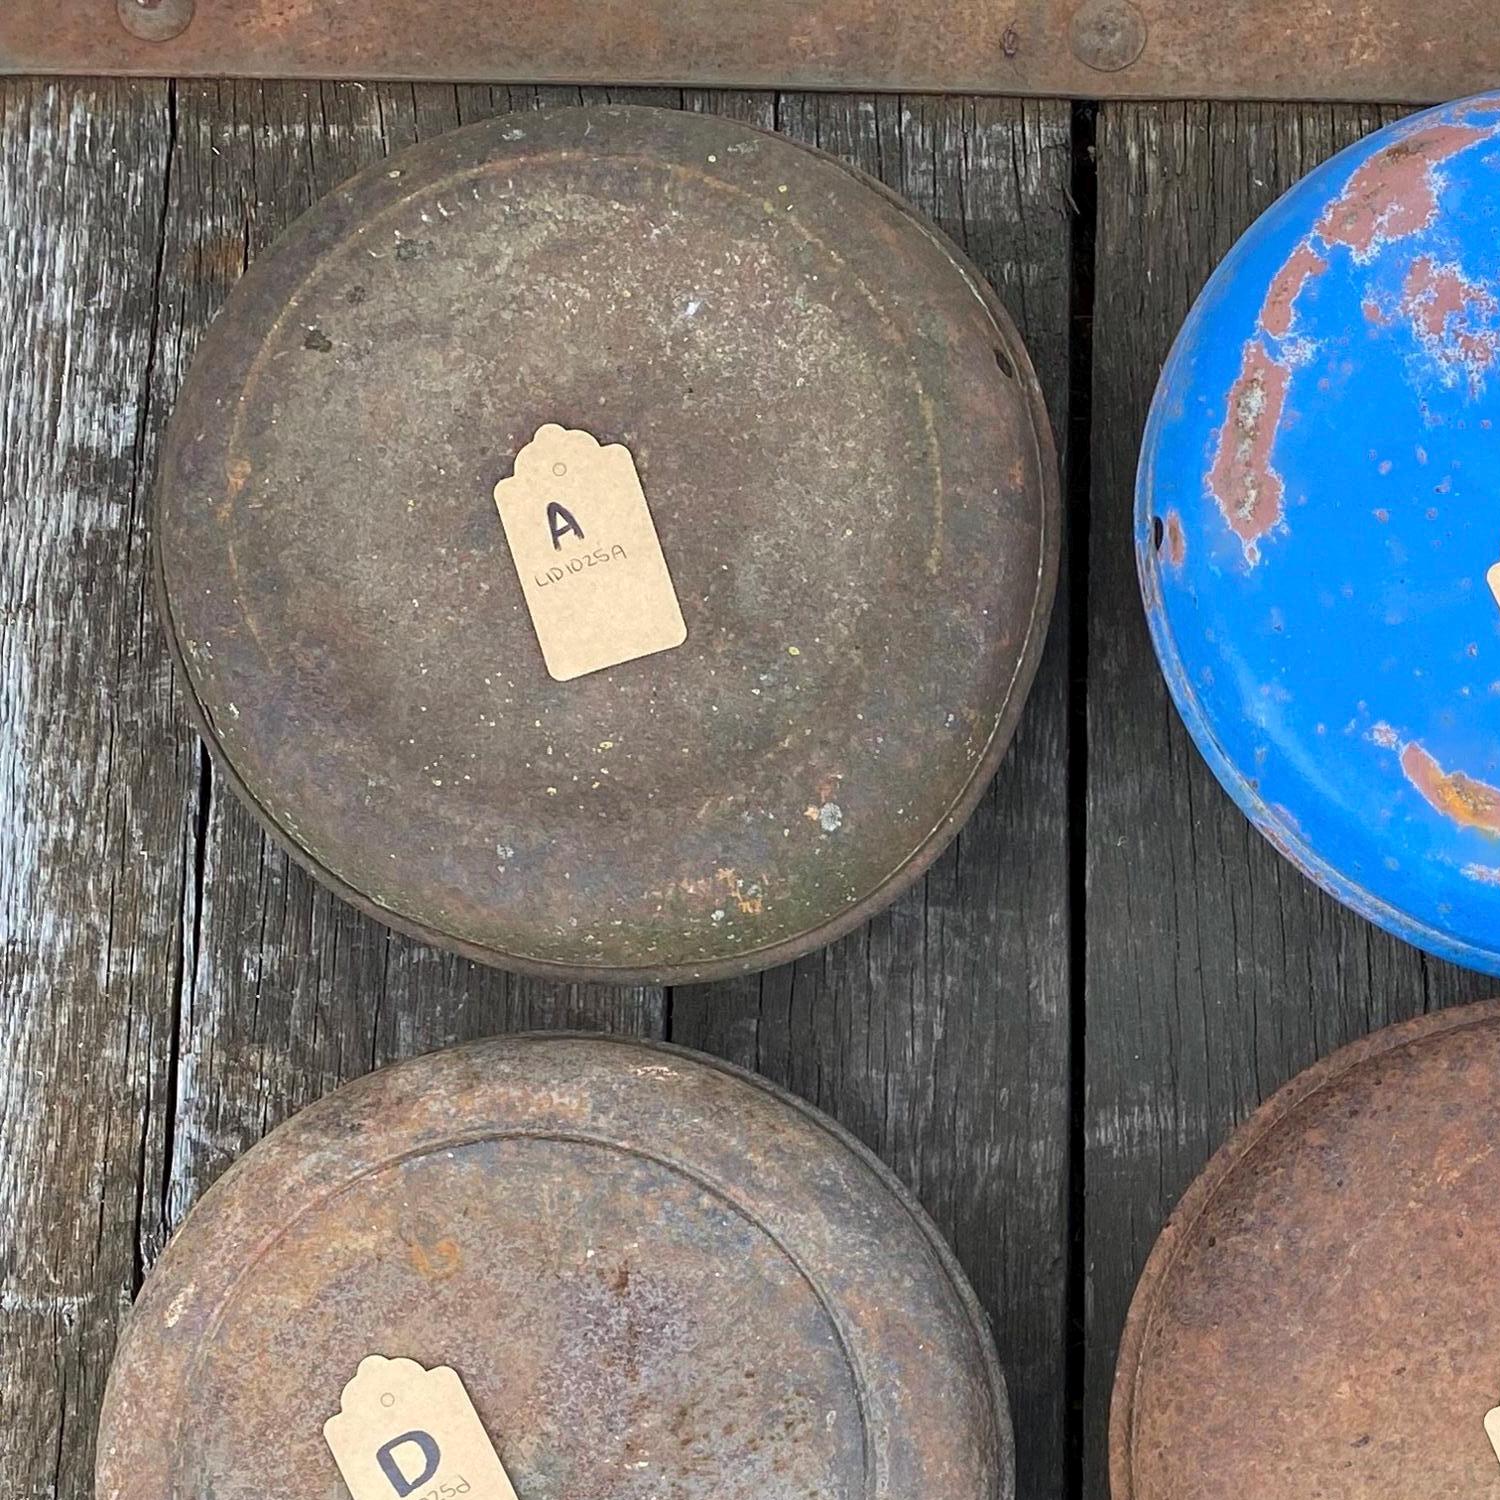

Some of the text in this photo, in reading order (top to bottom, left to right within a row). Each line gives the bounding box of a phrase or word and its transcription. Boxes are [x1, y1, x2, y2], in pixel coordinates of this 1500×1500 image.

[546, 501, 585, 551] A
[534, 544, 627, 588] LID1025A
[375, 1430, 441, 1498] D
